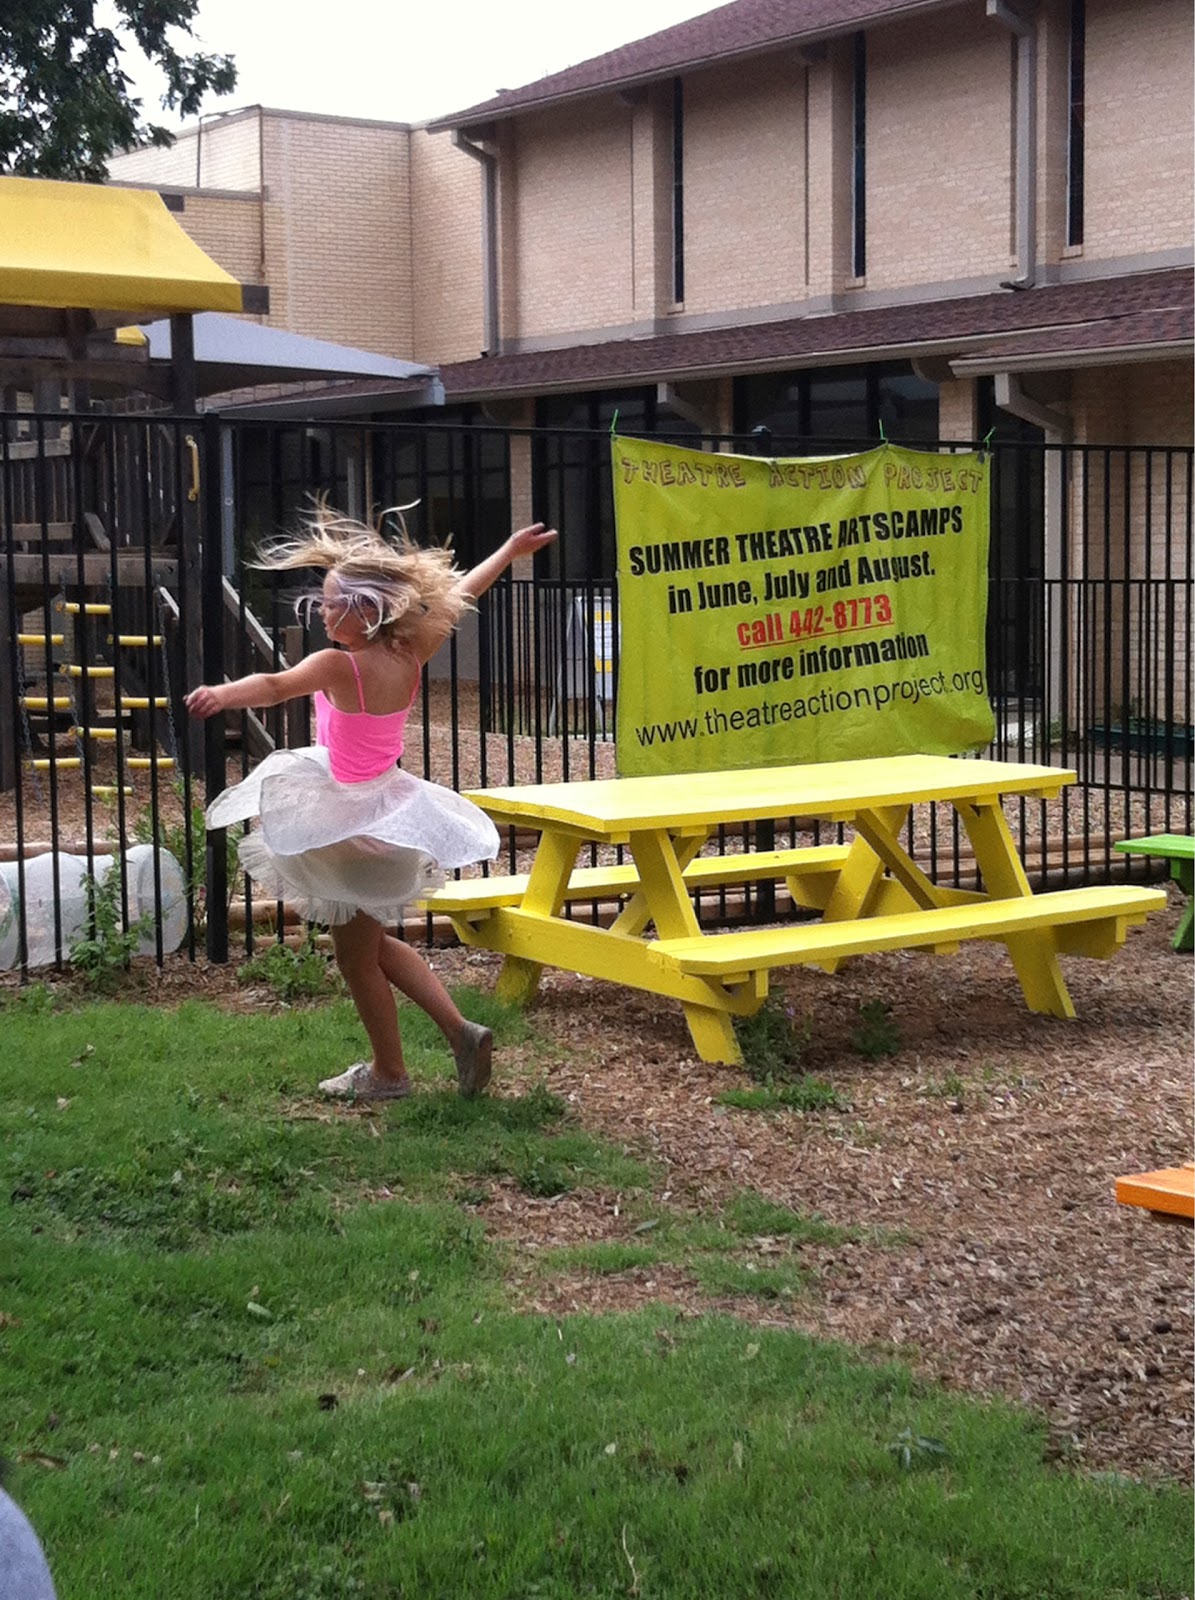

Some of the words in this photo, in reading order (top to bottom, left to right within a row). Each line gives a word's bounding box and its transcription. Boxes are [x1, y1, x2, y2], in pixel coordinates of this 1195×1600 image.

[622, 459, 746, 487] THEATRE
[768, 464, 867, 490] ACTION
[883, 462, 984, 494] PROJECT
[629, 536, 730, 576] SUMMER
[735, 524, 832, 562] THEATRE
[668, 585, 694, 614] in
[697, 578, 758, 611] June,
[763, 569, 810, 604] July
[815, 559, 851, 592] and
[857, 551, 935, 585] August.
[737, 614, 783, 647] call
[788, 594, 892, 636] 442-8773
[693, 664, 731, 695] for
[737, 656, 795, 687] more
[799, 632, 929, 676] information
[635, 669, 983, 747] www.theatreactionproject.org
